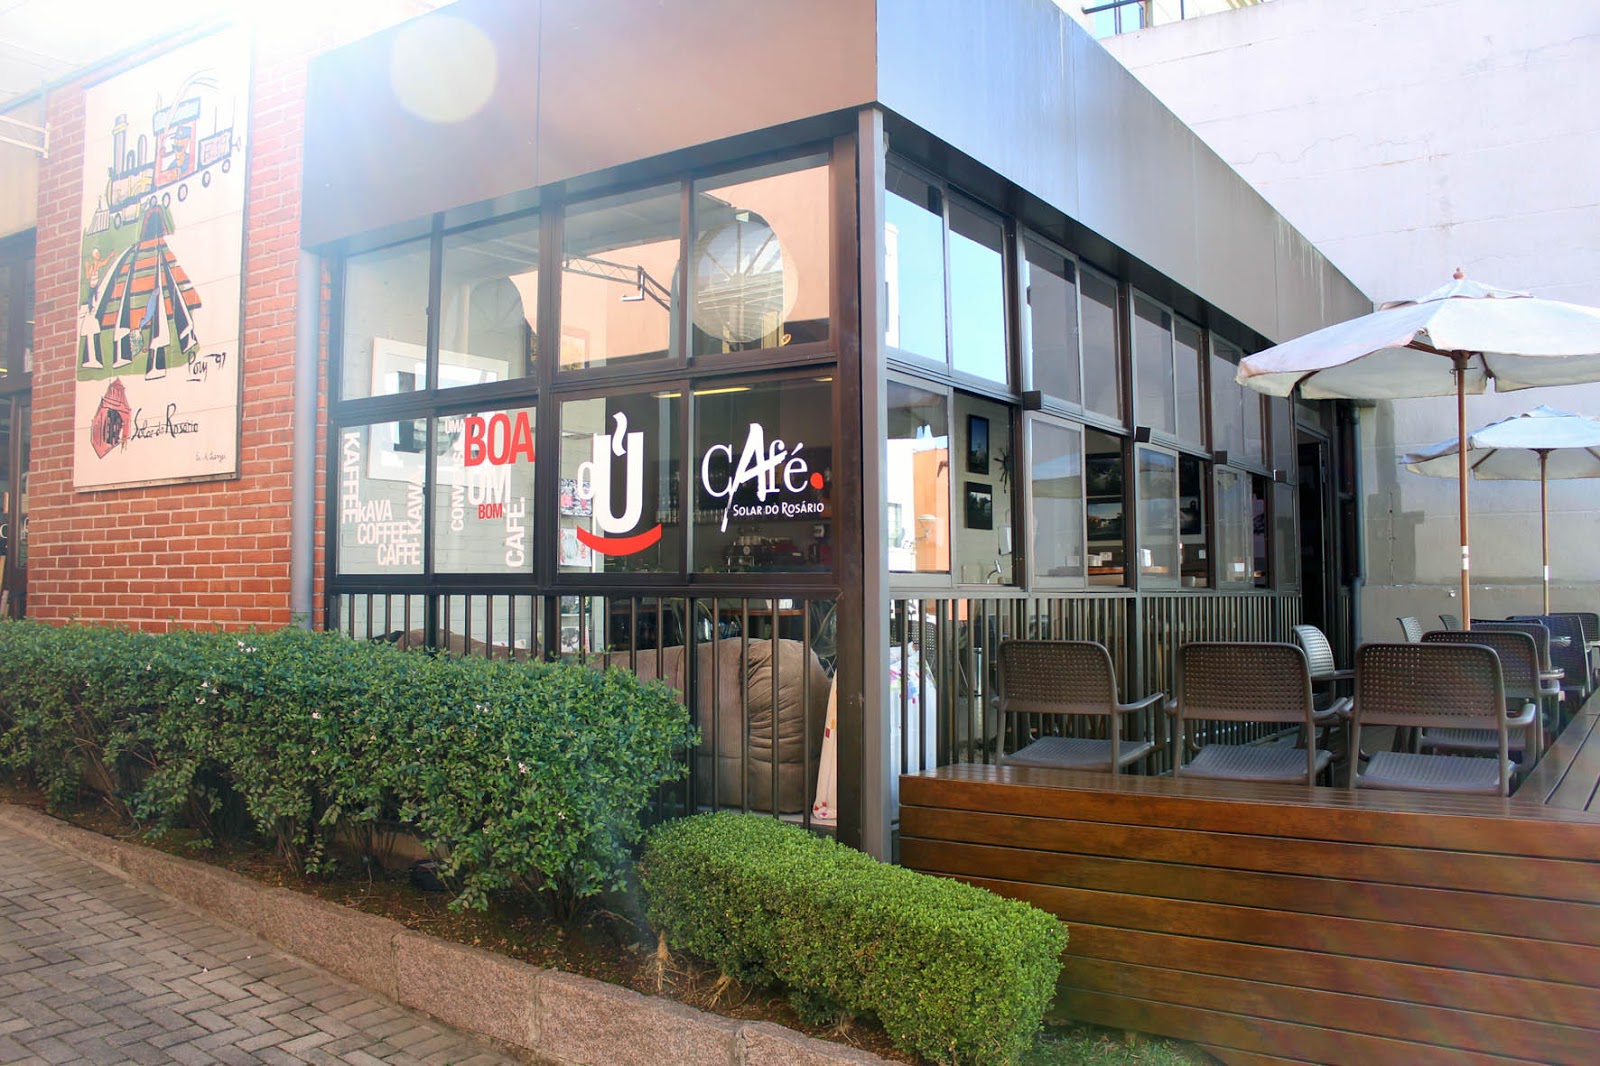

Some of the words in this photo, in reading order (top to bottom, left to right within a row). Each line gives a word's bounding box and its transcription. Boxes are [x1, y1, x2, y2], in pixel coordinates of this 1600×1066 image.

[464, 411, 536, 467] BOA
[342, 431, 361, 524] KAFFEE
[467, 464, 511, 506] UM
[478, 503, 503, 519] BOM
[357, 521, 409, 545] COFFEE
